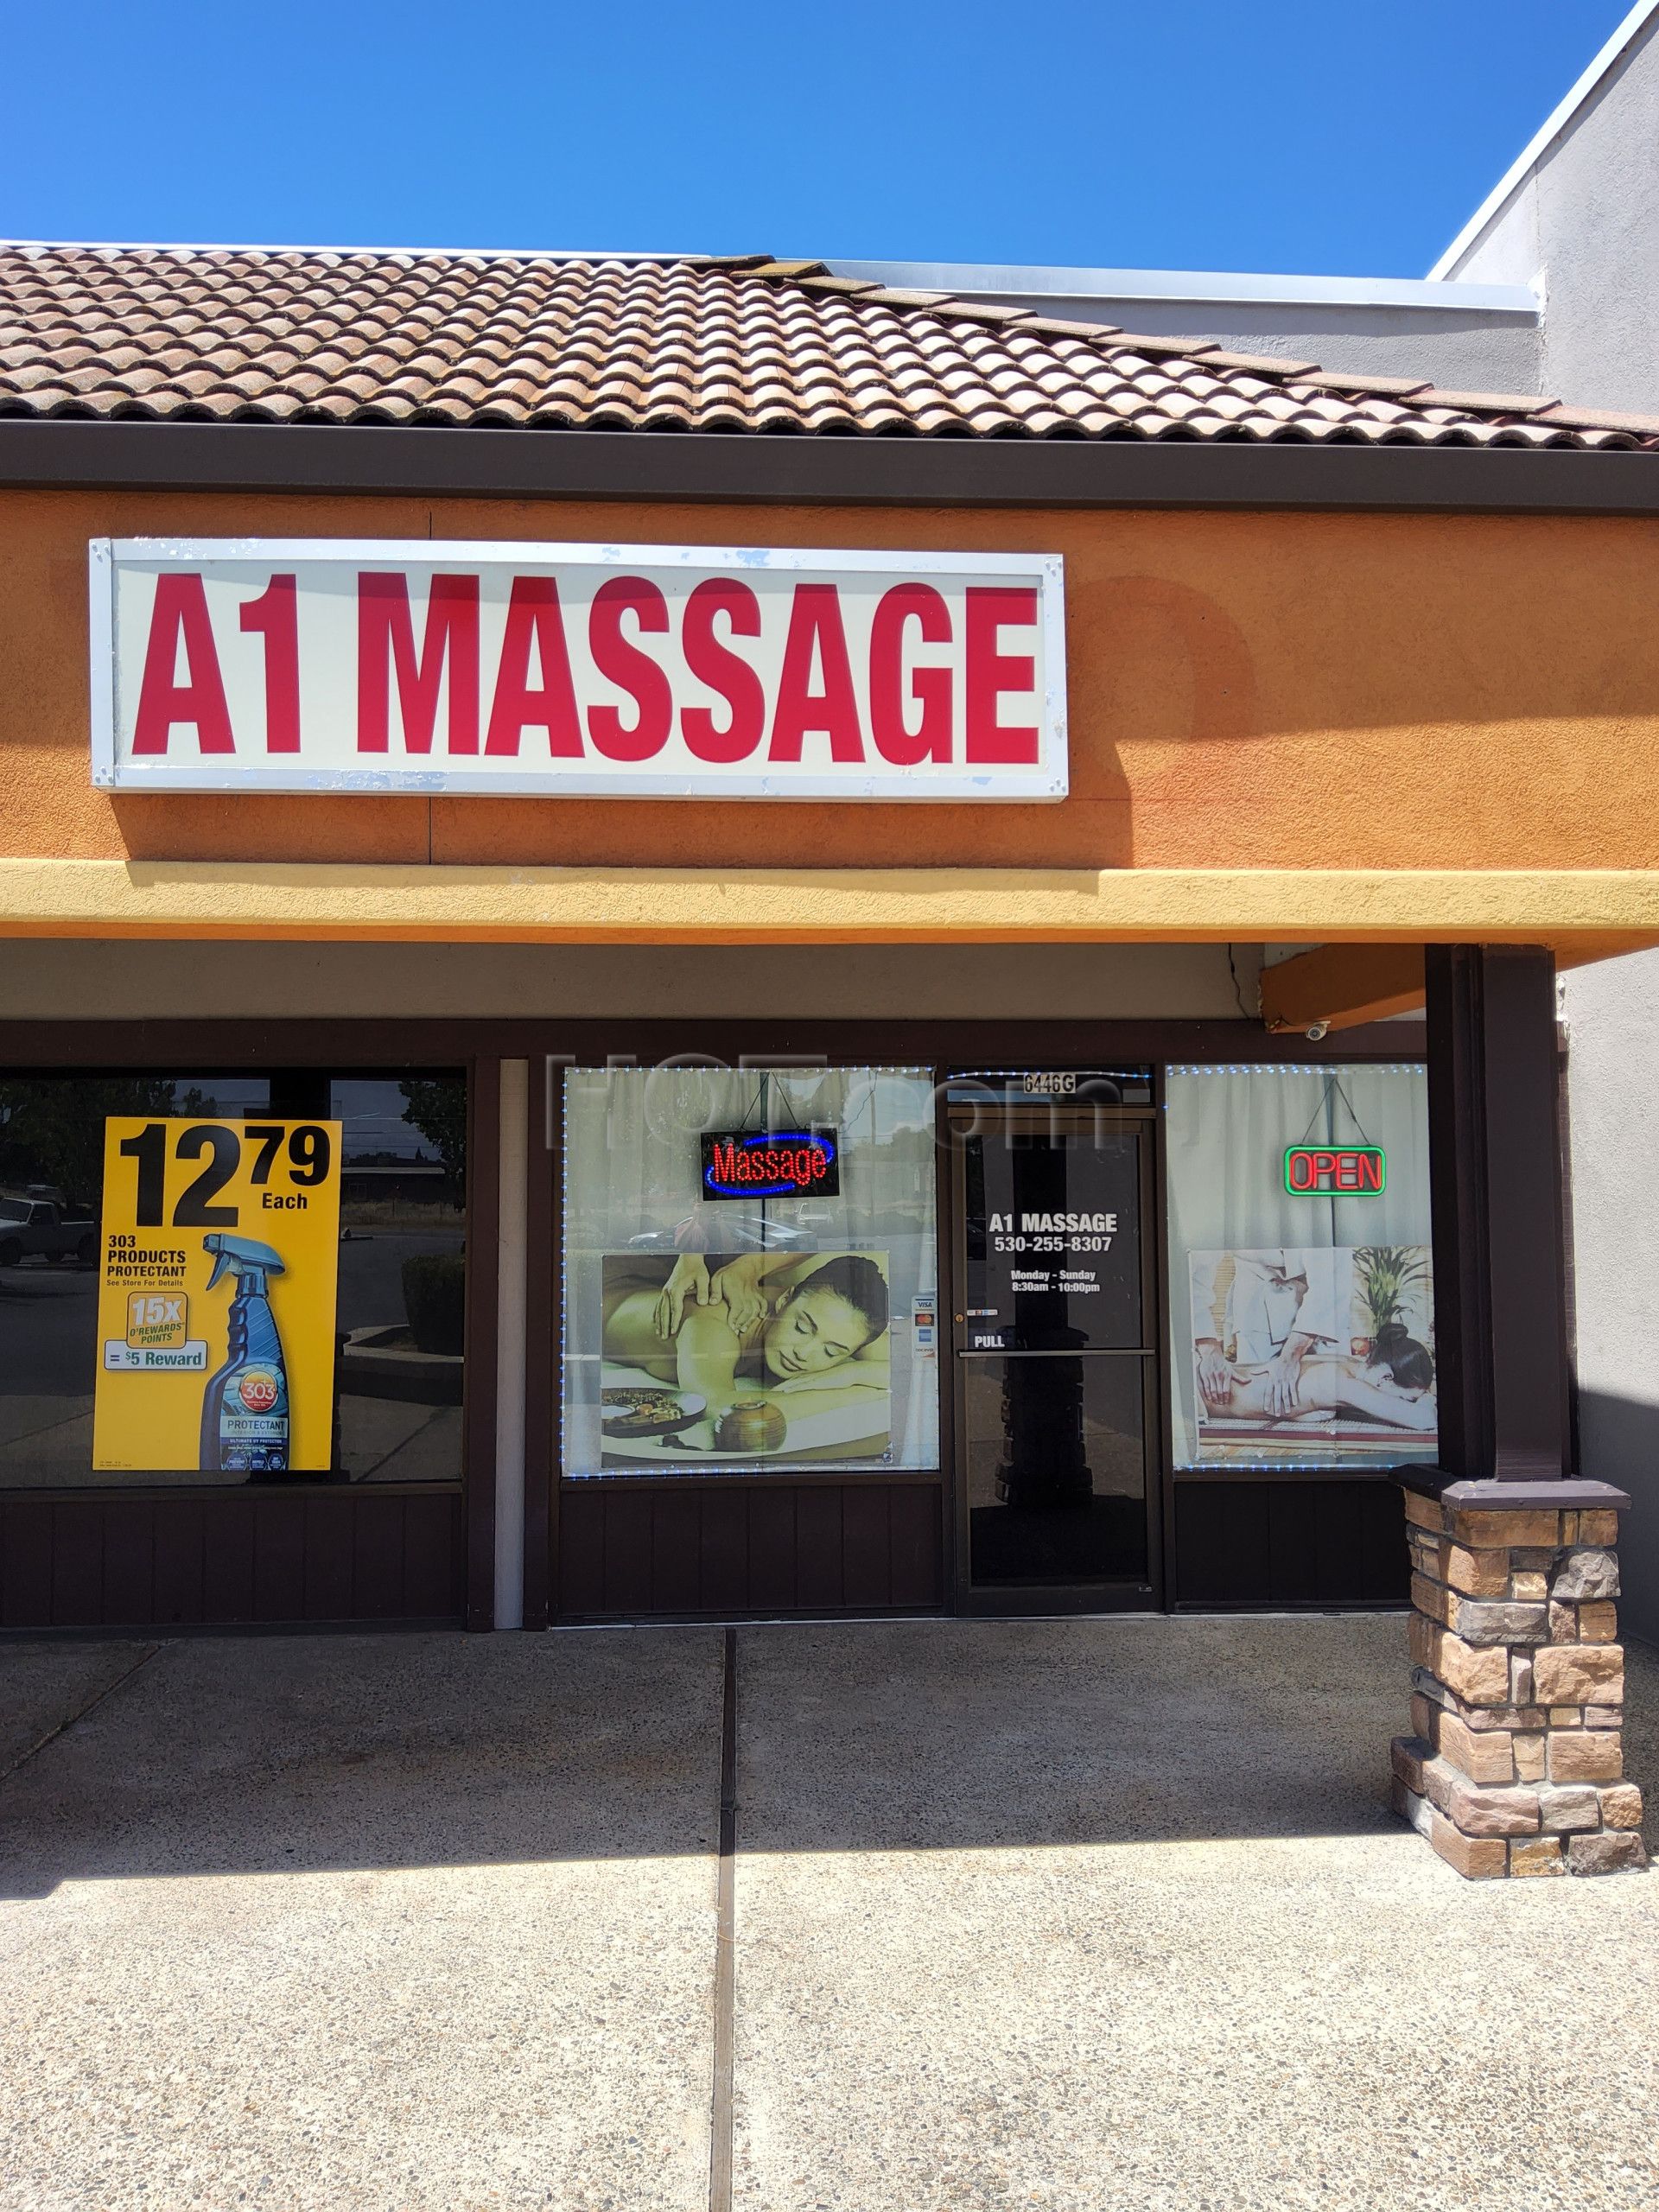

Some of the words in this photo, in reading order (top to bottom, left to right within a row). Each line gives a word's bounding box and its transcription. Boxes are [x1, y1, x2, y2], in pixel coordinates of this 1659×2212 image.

[133, 572, 301, 756] A1
[357, 572, 1040, 766] MASSAGE
[1025, 1074, 1075, 1093] 6446G
[712, 1142, 827, 1186] Massage
[1288, 1152, 1382, 1191] OPEN
[262, 1192, 308, 1210] Each
[988, 1213, 1013, 1232] A1
[1021, 1212, 1118, 1233] MASSAGE
[108, 1235, 137, 1248] 303
[995, 1236, 1113, 1252] 530-255-8307
[107, 1249, 187, 1263] PRODUCTS
[106, 1266, 188, 1277] PROTECTANT
[1010, 1270, 1051, 1282] Monday
[1059, 1269, 1096, 1282] Sunday
[1012, 1282, 1049, 1292] 8:30am
[1058, 1282, 1101, 1294] 10:00pm
[141, 1332, 173, 1344] POINTS
[974, 1335, 1006, 1348] PULL
[125, 1351, 140, 1365] $5
[145, 1351, 202, 1366] Reward
[244, 1382, 275, 1400] 303
[227, 1420, 284, 1431] PROTECTANT
